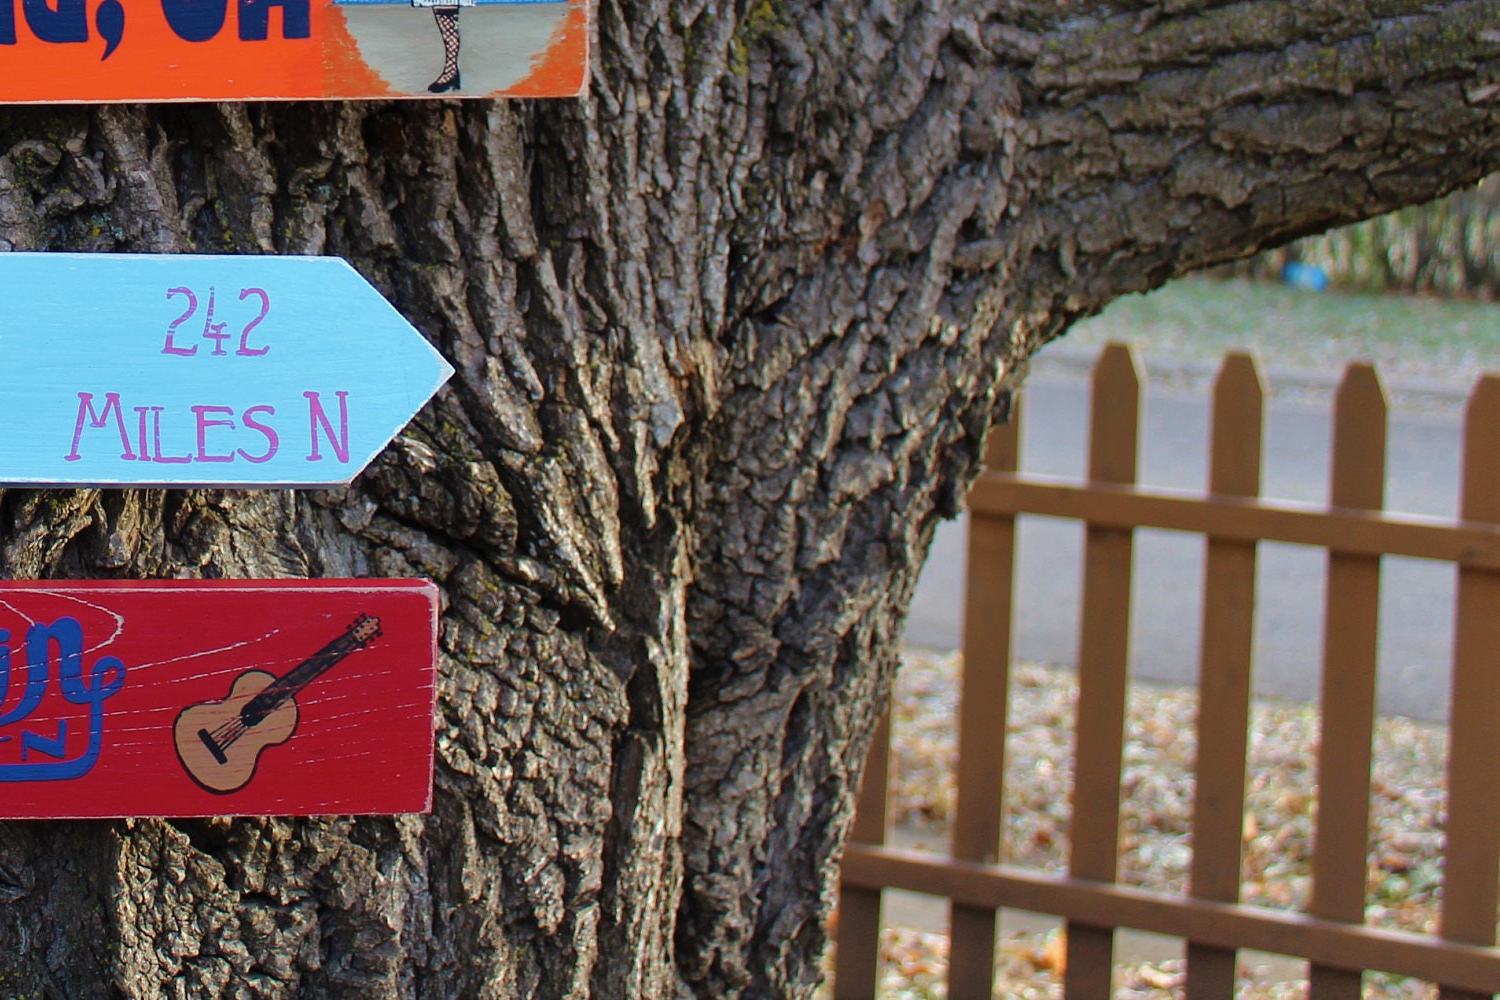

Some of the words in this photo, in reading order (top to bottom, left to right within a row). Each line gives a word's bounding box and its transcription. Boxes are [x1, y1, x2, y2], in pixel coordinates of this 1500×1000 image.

[160, 286, 271, 357] 242
[64, 391, 280, 464] MILES
[303, 390, 350, 464] N
